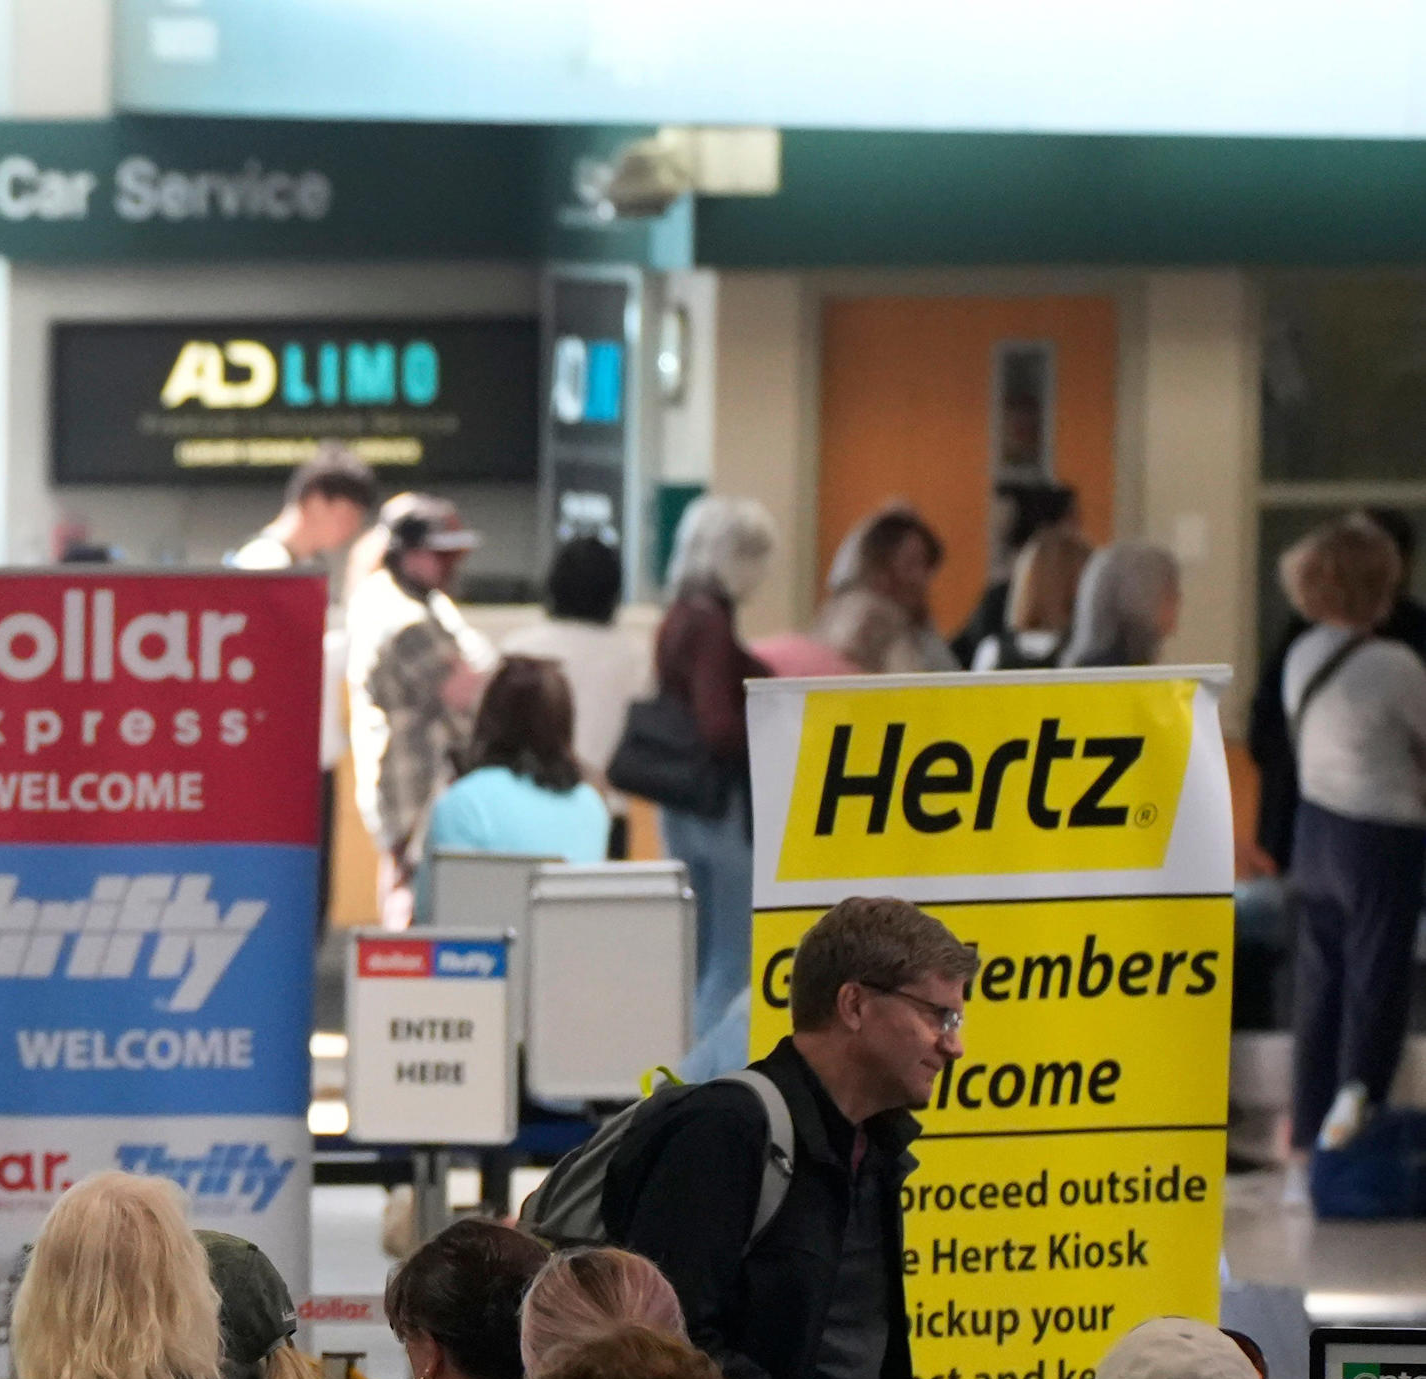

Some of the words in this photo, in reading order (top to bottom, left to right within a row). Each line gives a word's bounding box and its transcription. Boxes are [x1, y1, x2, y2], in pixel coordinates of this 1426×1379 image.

[115, 155, 332, 220] Service
[282, 340, 439, 408] LIMO
[814, 717, 1146, 836] Hertz
[964, 934, 1219, 1002] embers
[16, 1029, 255, 1070] WELCOME
[389, 1018, 474, 1041] ENTER
[396, 1061, 465, 1085] HERE
[907, 1055, 1122, 1112] lcome
[1059, 1164, 1208, 1206] outside
[932, 1237, 1037, 1275] Hertz
[1048, 1228, 1150, 1270] Kiosk
[1031, 1302, 1116, 1345] your
